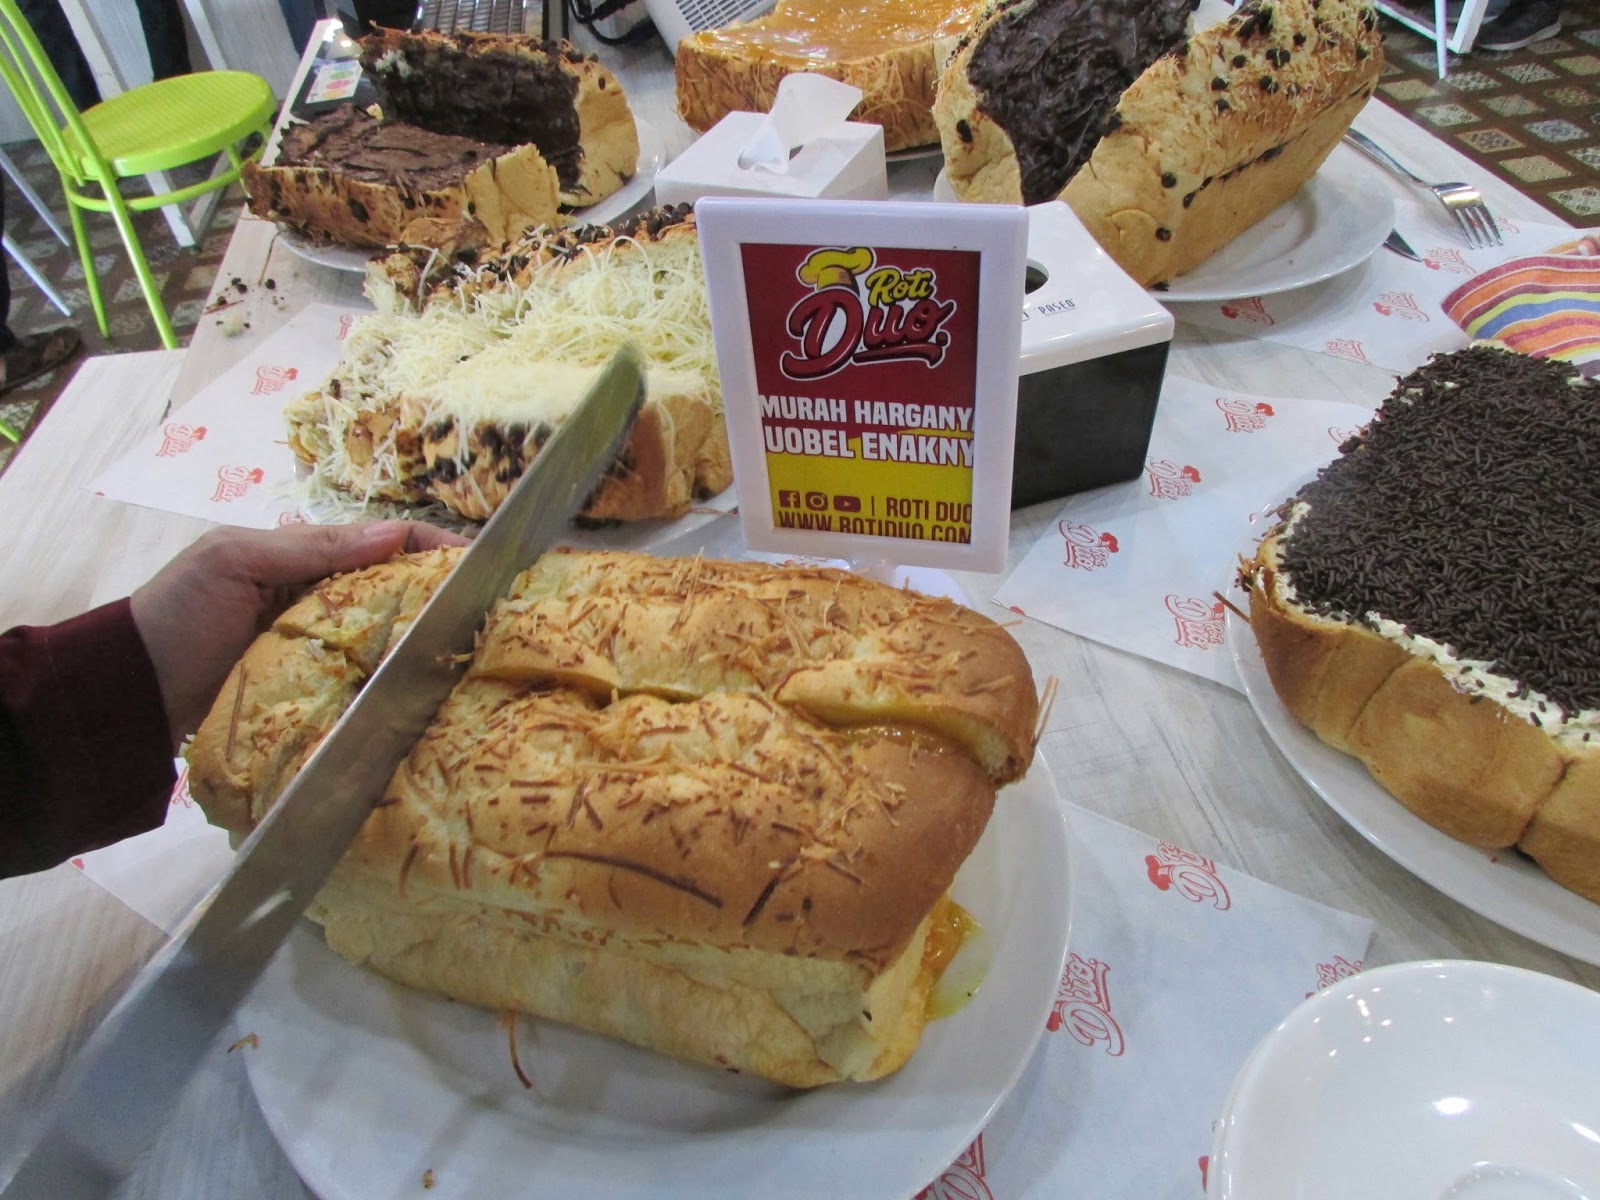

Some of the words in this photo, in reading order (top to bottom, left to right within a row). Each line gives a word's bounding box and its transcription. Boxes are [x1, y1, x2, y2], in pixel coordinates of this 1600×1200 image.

[865, 266, 935, 307] Roti
[760, 395, 847, 423] MURAH
[854, 399, 974, 432] HARGANY
[886, 497, 930, 520] ROTI
[778, 511, 972, 544] WWWROTIDUOCOM
